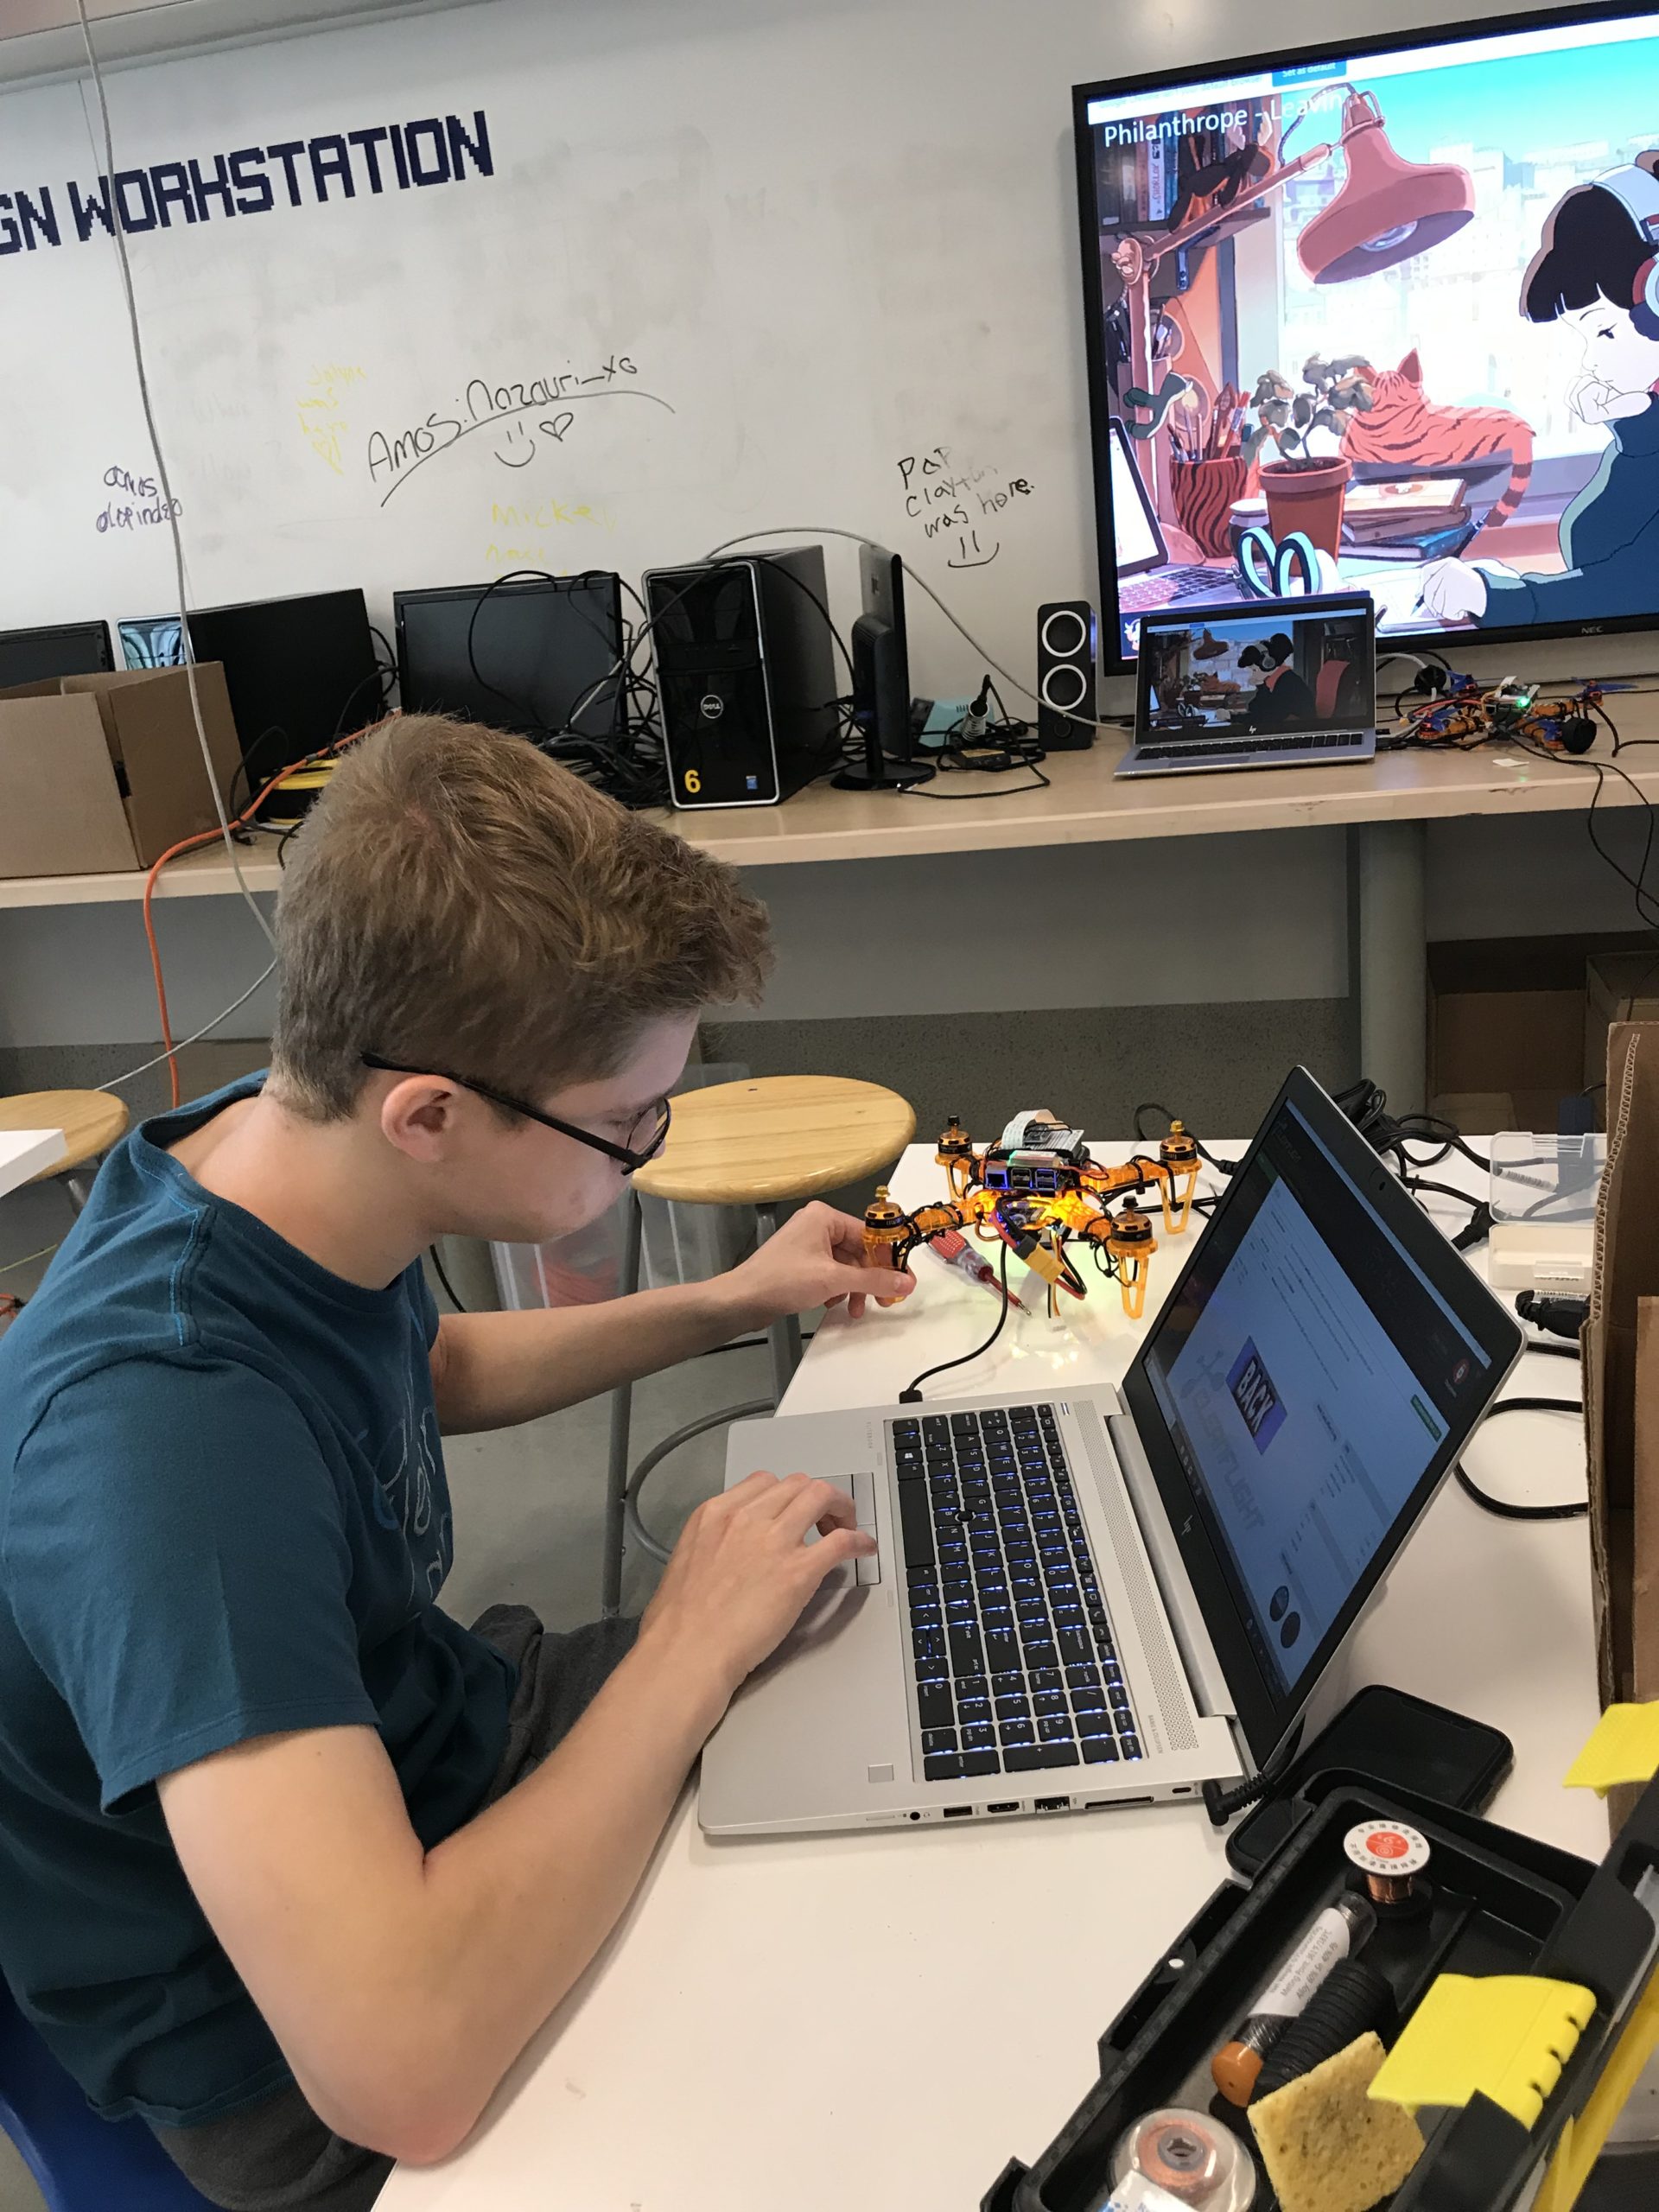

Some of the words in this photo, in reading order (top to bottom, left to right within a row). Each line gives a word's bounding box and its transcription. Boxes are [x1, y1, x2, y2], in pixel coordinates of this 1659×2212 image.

[1104, 109, 1248, 148] Philanthrope
[67, 111, 493, 242] WORKSTATION
[925, 504, 969, 538] was
[1581, 626, 1604, 634] NEC
[684, 769, 701, 793] 6
[1235, 1358, 1276, 1436] BACK
